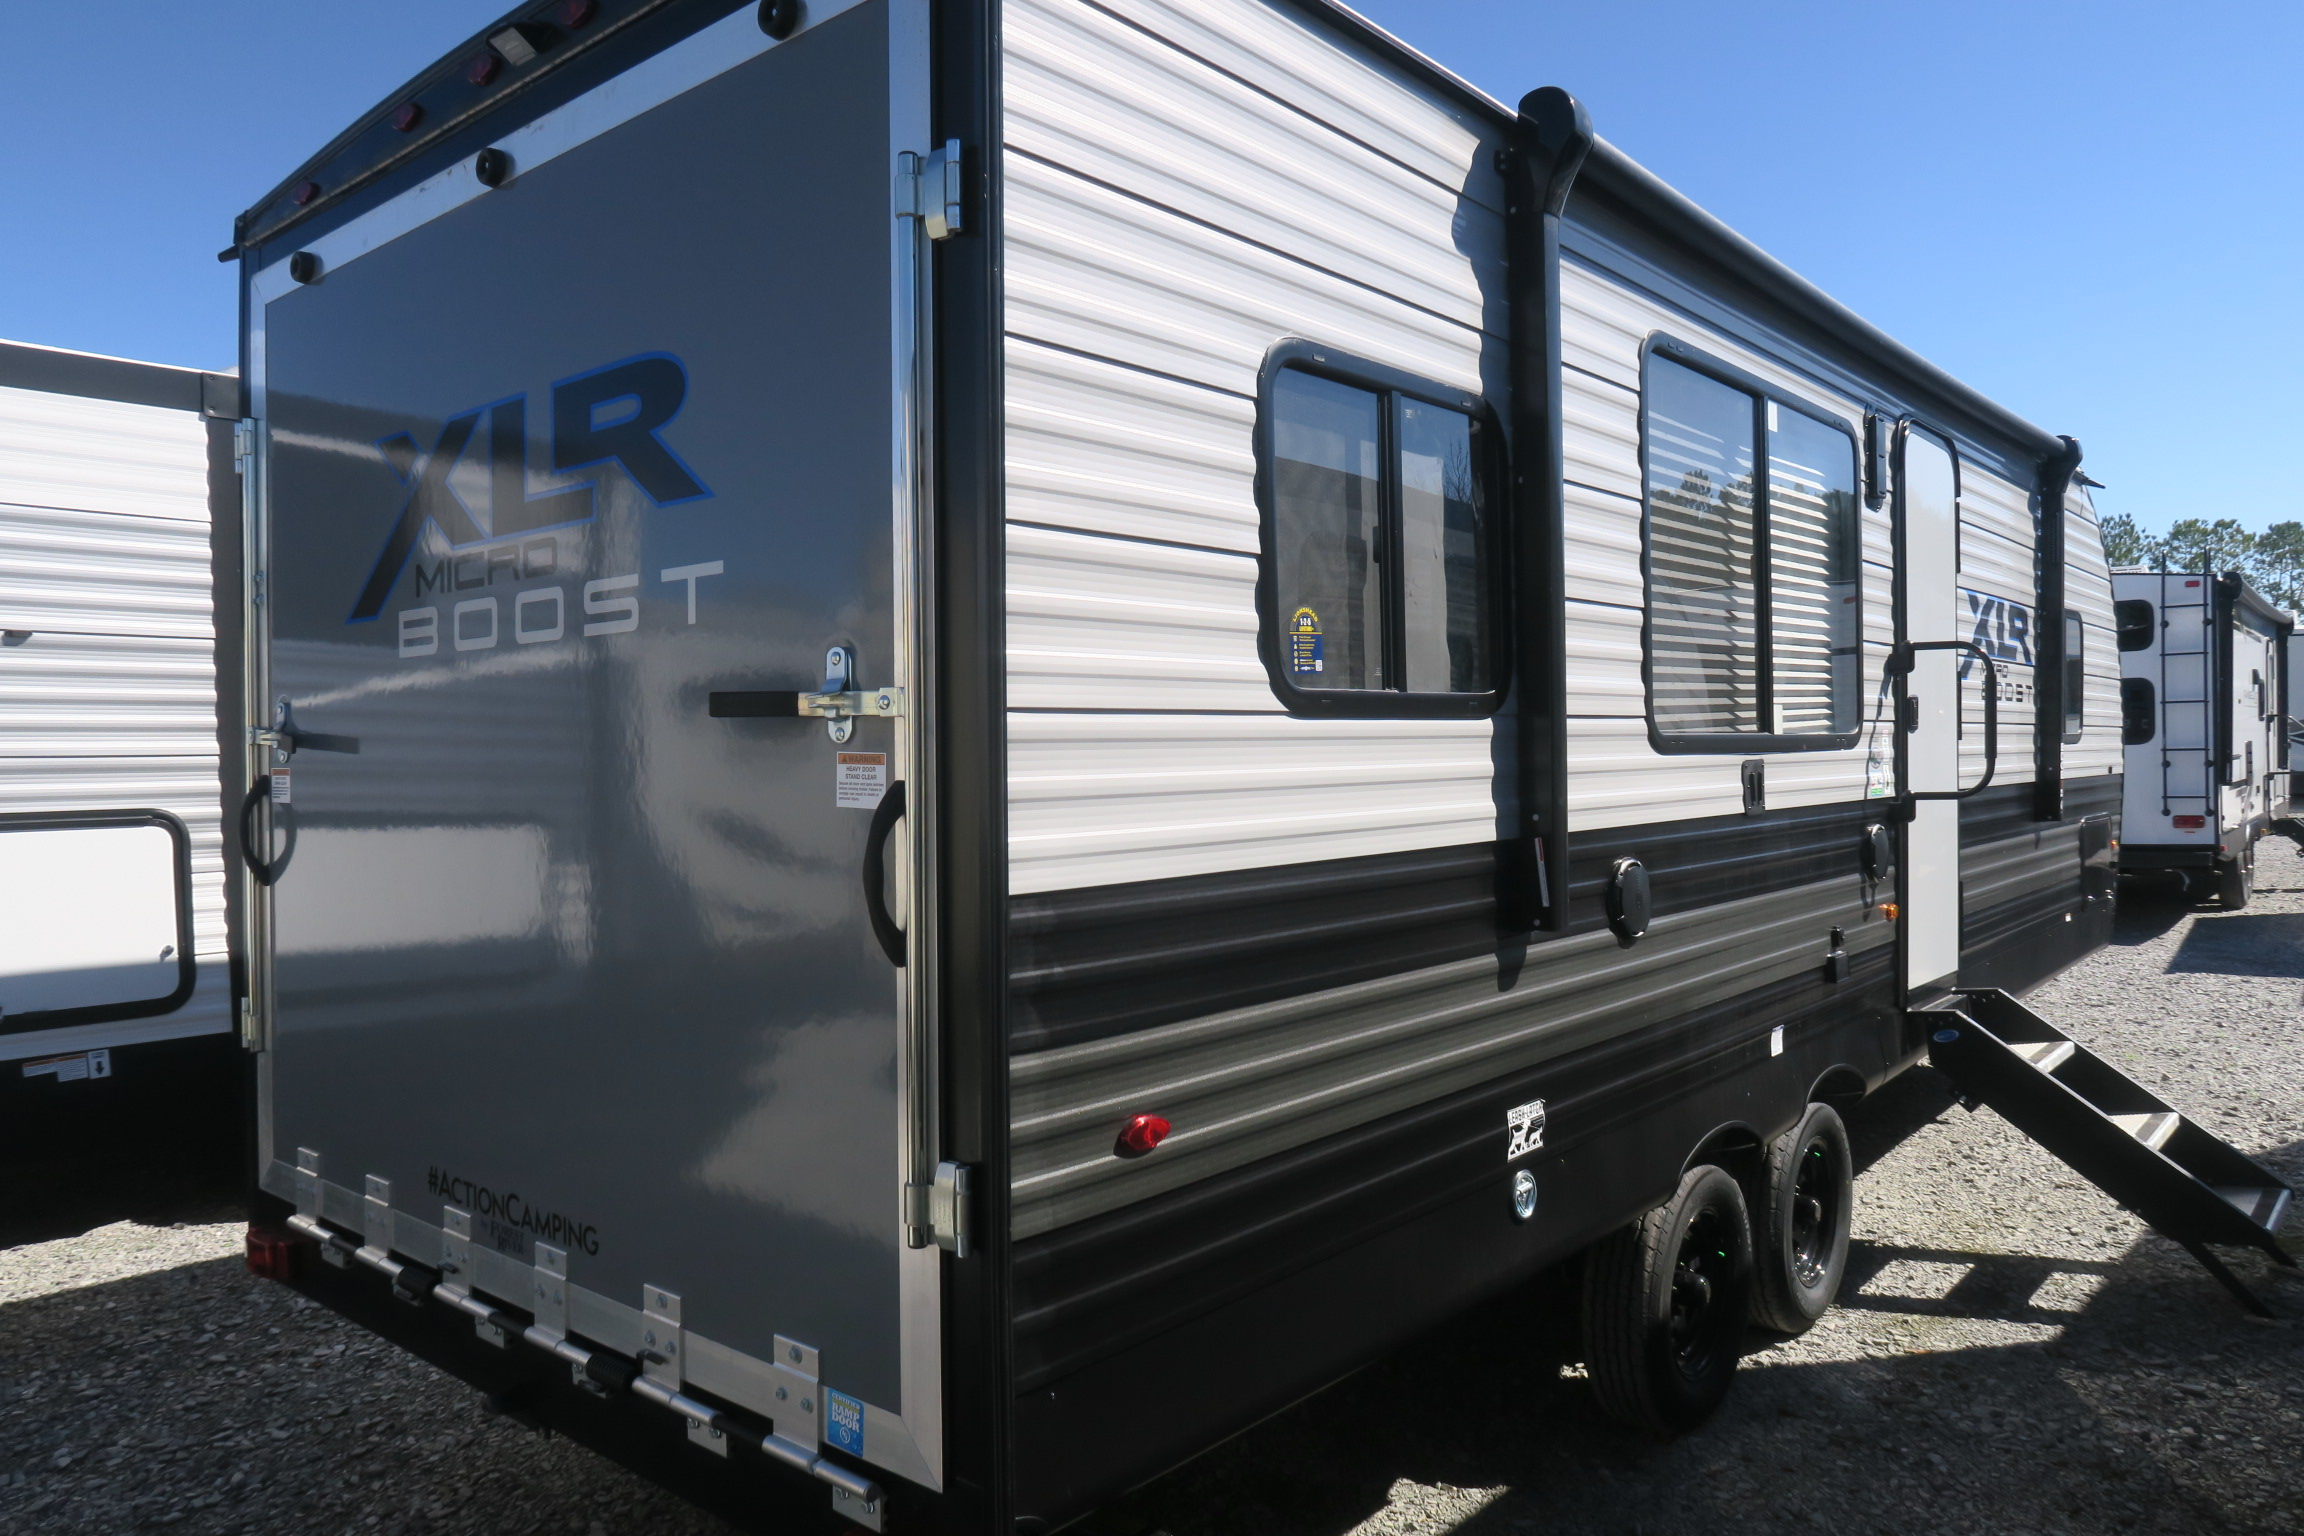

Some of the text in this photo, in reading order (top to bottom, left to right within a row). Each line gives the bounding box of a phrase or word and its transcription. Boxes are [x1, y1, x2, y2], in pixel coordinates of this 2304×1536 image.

[345, 351, 715, 625] XLR
[416, 537, 558, 598] MICRO
[399, 560, 724, 658] BOOST
[1960, 590, 2033, 680] XLR
[1980, 662, 2008, 678] MRO
[848, 755, 881, 763] WARNING
[832, 1402, 860, 1421] RAMP
[832, 1411, 859, 1432] DOOR
